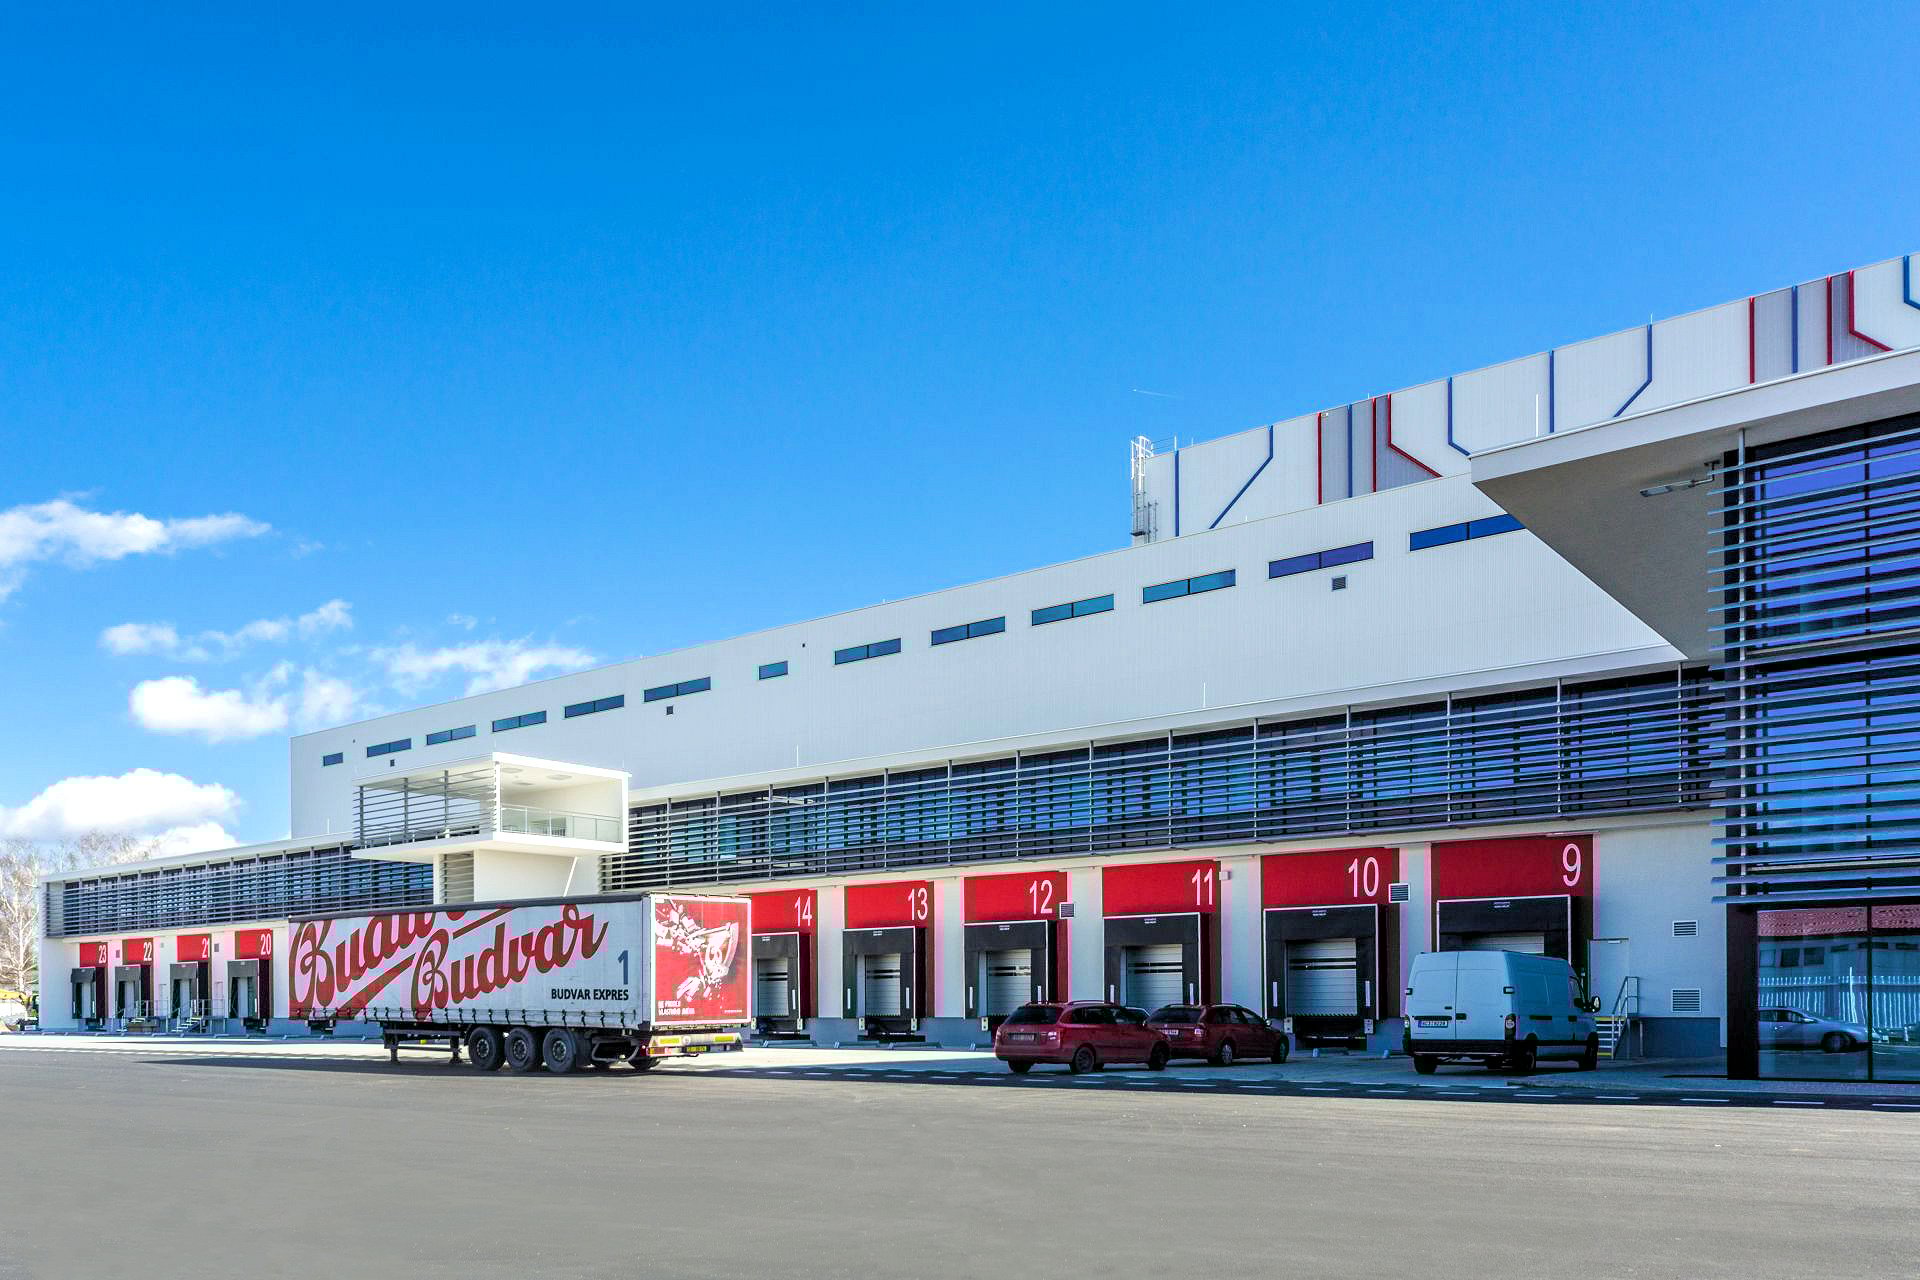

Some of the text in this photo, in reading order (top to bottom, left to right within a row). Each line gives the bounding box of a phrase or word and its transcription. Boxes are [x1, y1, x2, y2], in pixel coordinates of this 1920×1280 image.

[1347, 856, 1380, 898] 10
[1562, 843, 1582, 887] 9
[906, 887, 929, 921] 13
[1028, 879, 1053, 915] 12
[1190, 868, 1214, 906] 11
[793, 895, 813, 927] 14
[98, 944, 107, 964] 23
[143, 941, 153, 962] 22
[201, 937, 211, 959] 21
[260, 933, 272, 956] 20
[411, 904, 609, 1020] Budvar
[617, 949, 629, 985] 1
[551, 988, 629, 1001] BUDVAR EXPRES
